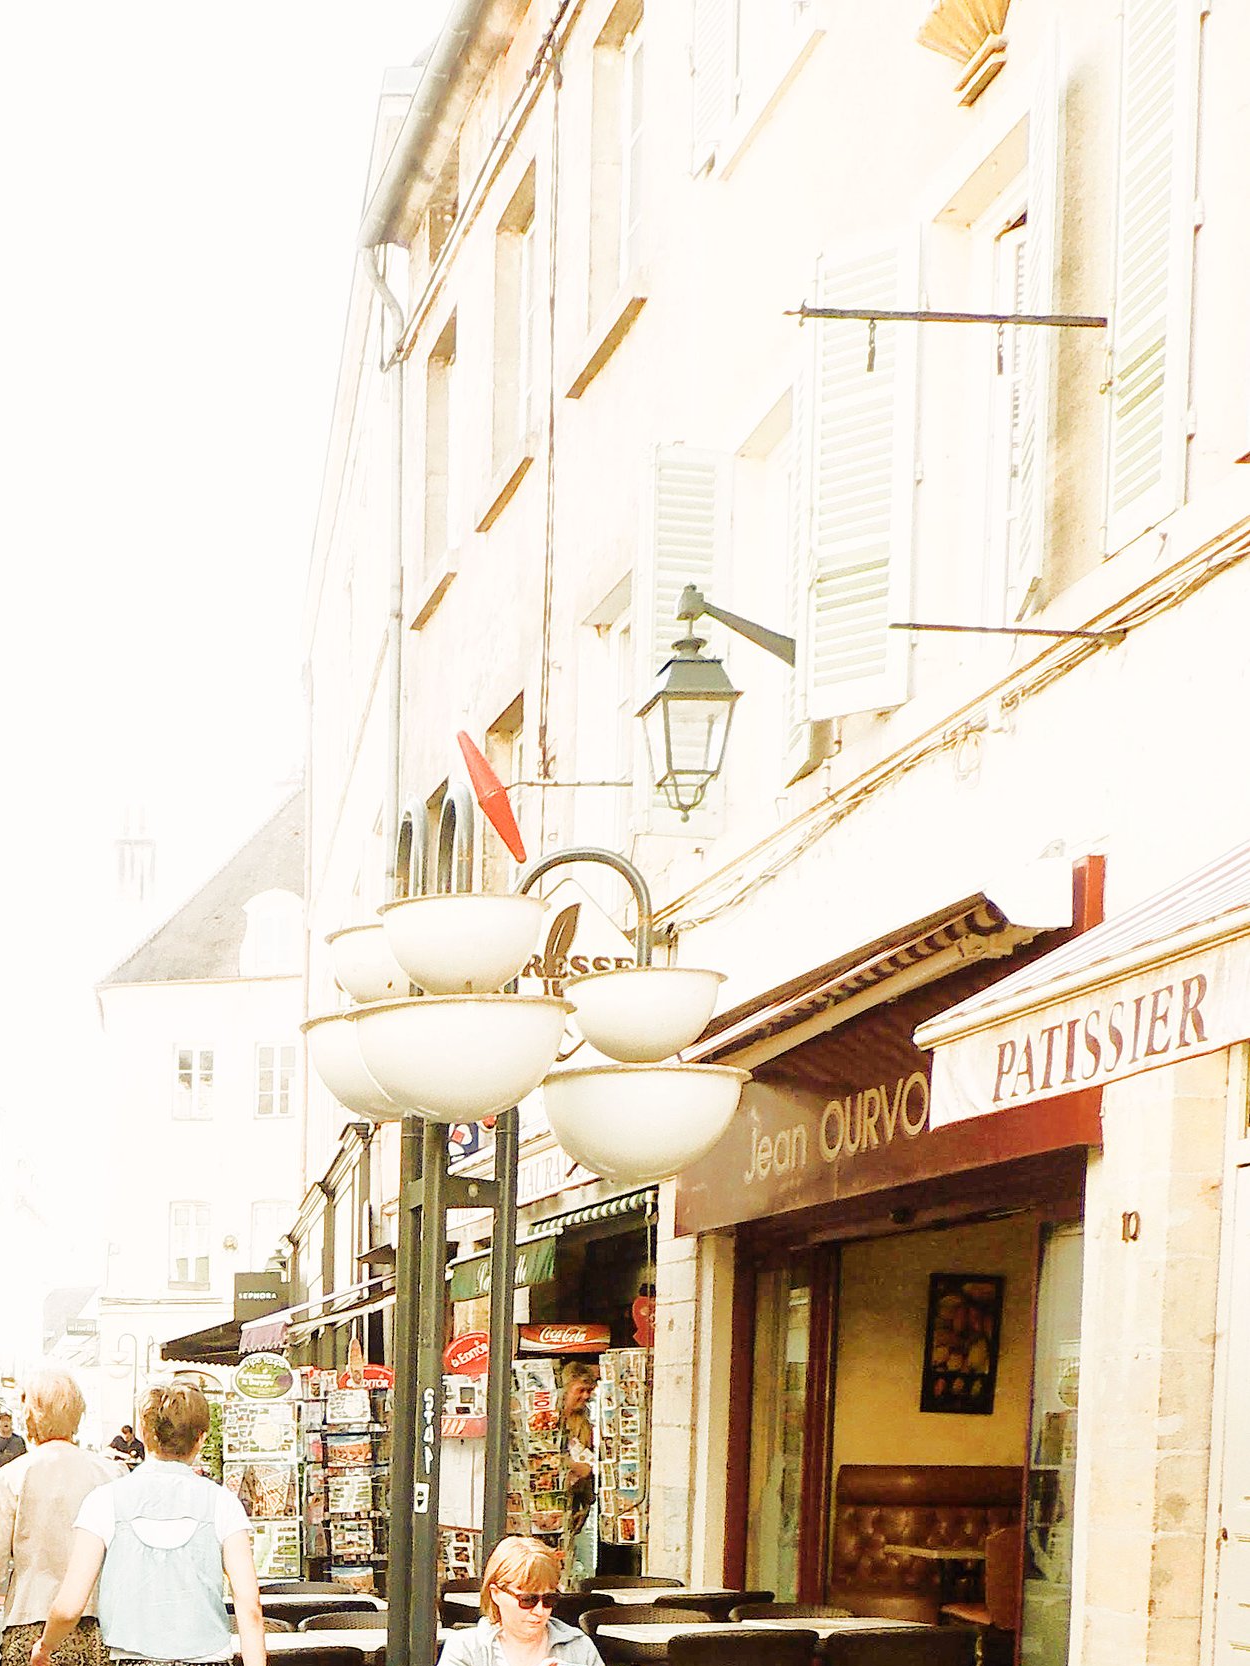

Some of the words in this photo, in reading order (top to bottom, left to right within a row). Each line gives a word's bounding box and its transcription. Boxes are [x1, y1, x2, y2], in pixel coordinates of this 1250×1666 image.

[993, 973, 1208, 1102] PATISSIER
[744, 1112, 807, 1184] Jean
[820, 1071, 929, 1163] OURVO
[238, 1292, 277, 1300] SEPHORA
